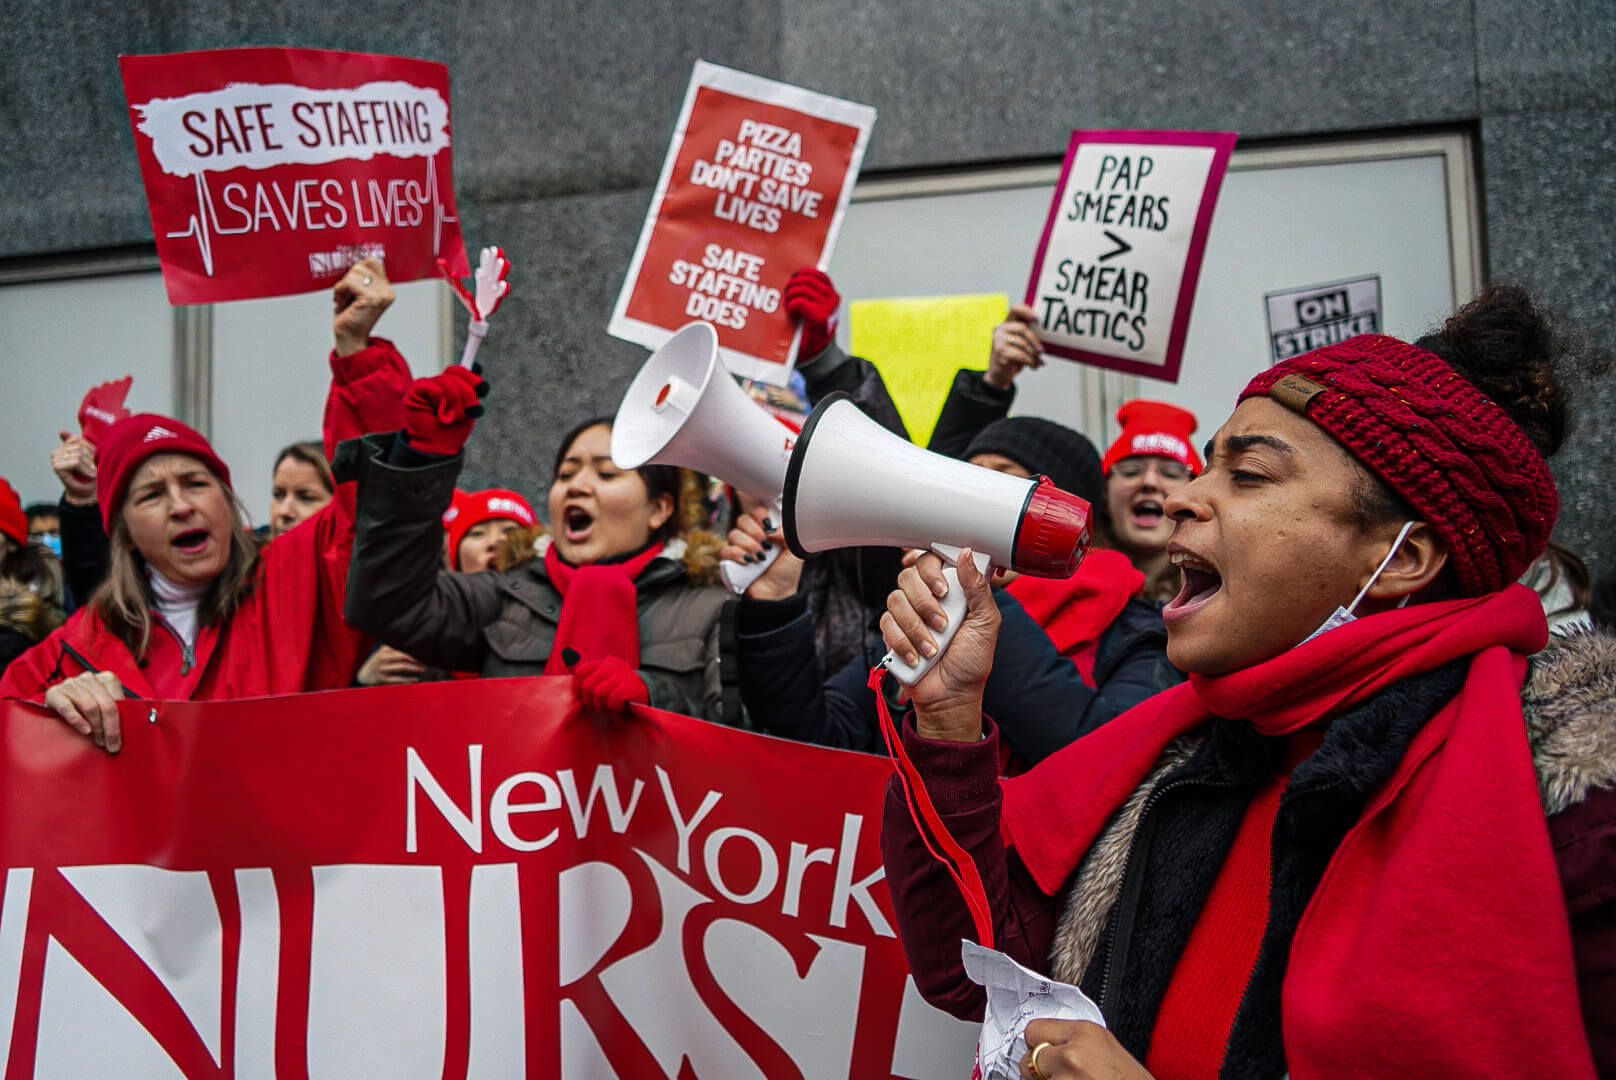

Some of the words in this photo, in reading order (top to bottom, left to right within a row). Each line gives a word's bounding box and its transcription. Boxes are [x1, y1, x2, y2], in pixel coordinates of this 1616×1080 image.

[182, 103, 283, 157] SAFE
[291, 101, 431, 148] STAFFING
[737, 119, 801, 157] PIZZA
[715, 139, 812, 186] PARTIES
[1095, 154, 1154, 192] PAP
[219, 178, 347, 234] SAVES
[352, 179, 428, 227] LIVES
[690, 160, 756, 200] DON'T
[758, 178, 823, 218] SAVE
[1067, 191, 1170, 231] SMEARS
[713, 194, 782, 233] LIVES
[702, 243, 765, 281] SAFE
[669, 260, 781, 314] STAFFING
[1055, 259, 1149, 314] SMEAR
[1299, 293, 1345, 322] ON
[686, 293, 749, 331] DOES
[1041, 296, 1148, 352] TACTICS
[1276, 314, 1376, 356] STRIKE
[406, 744, 645, 854] New
[655, 765, 897, 938] York
